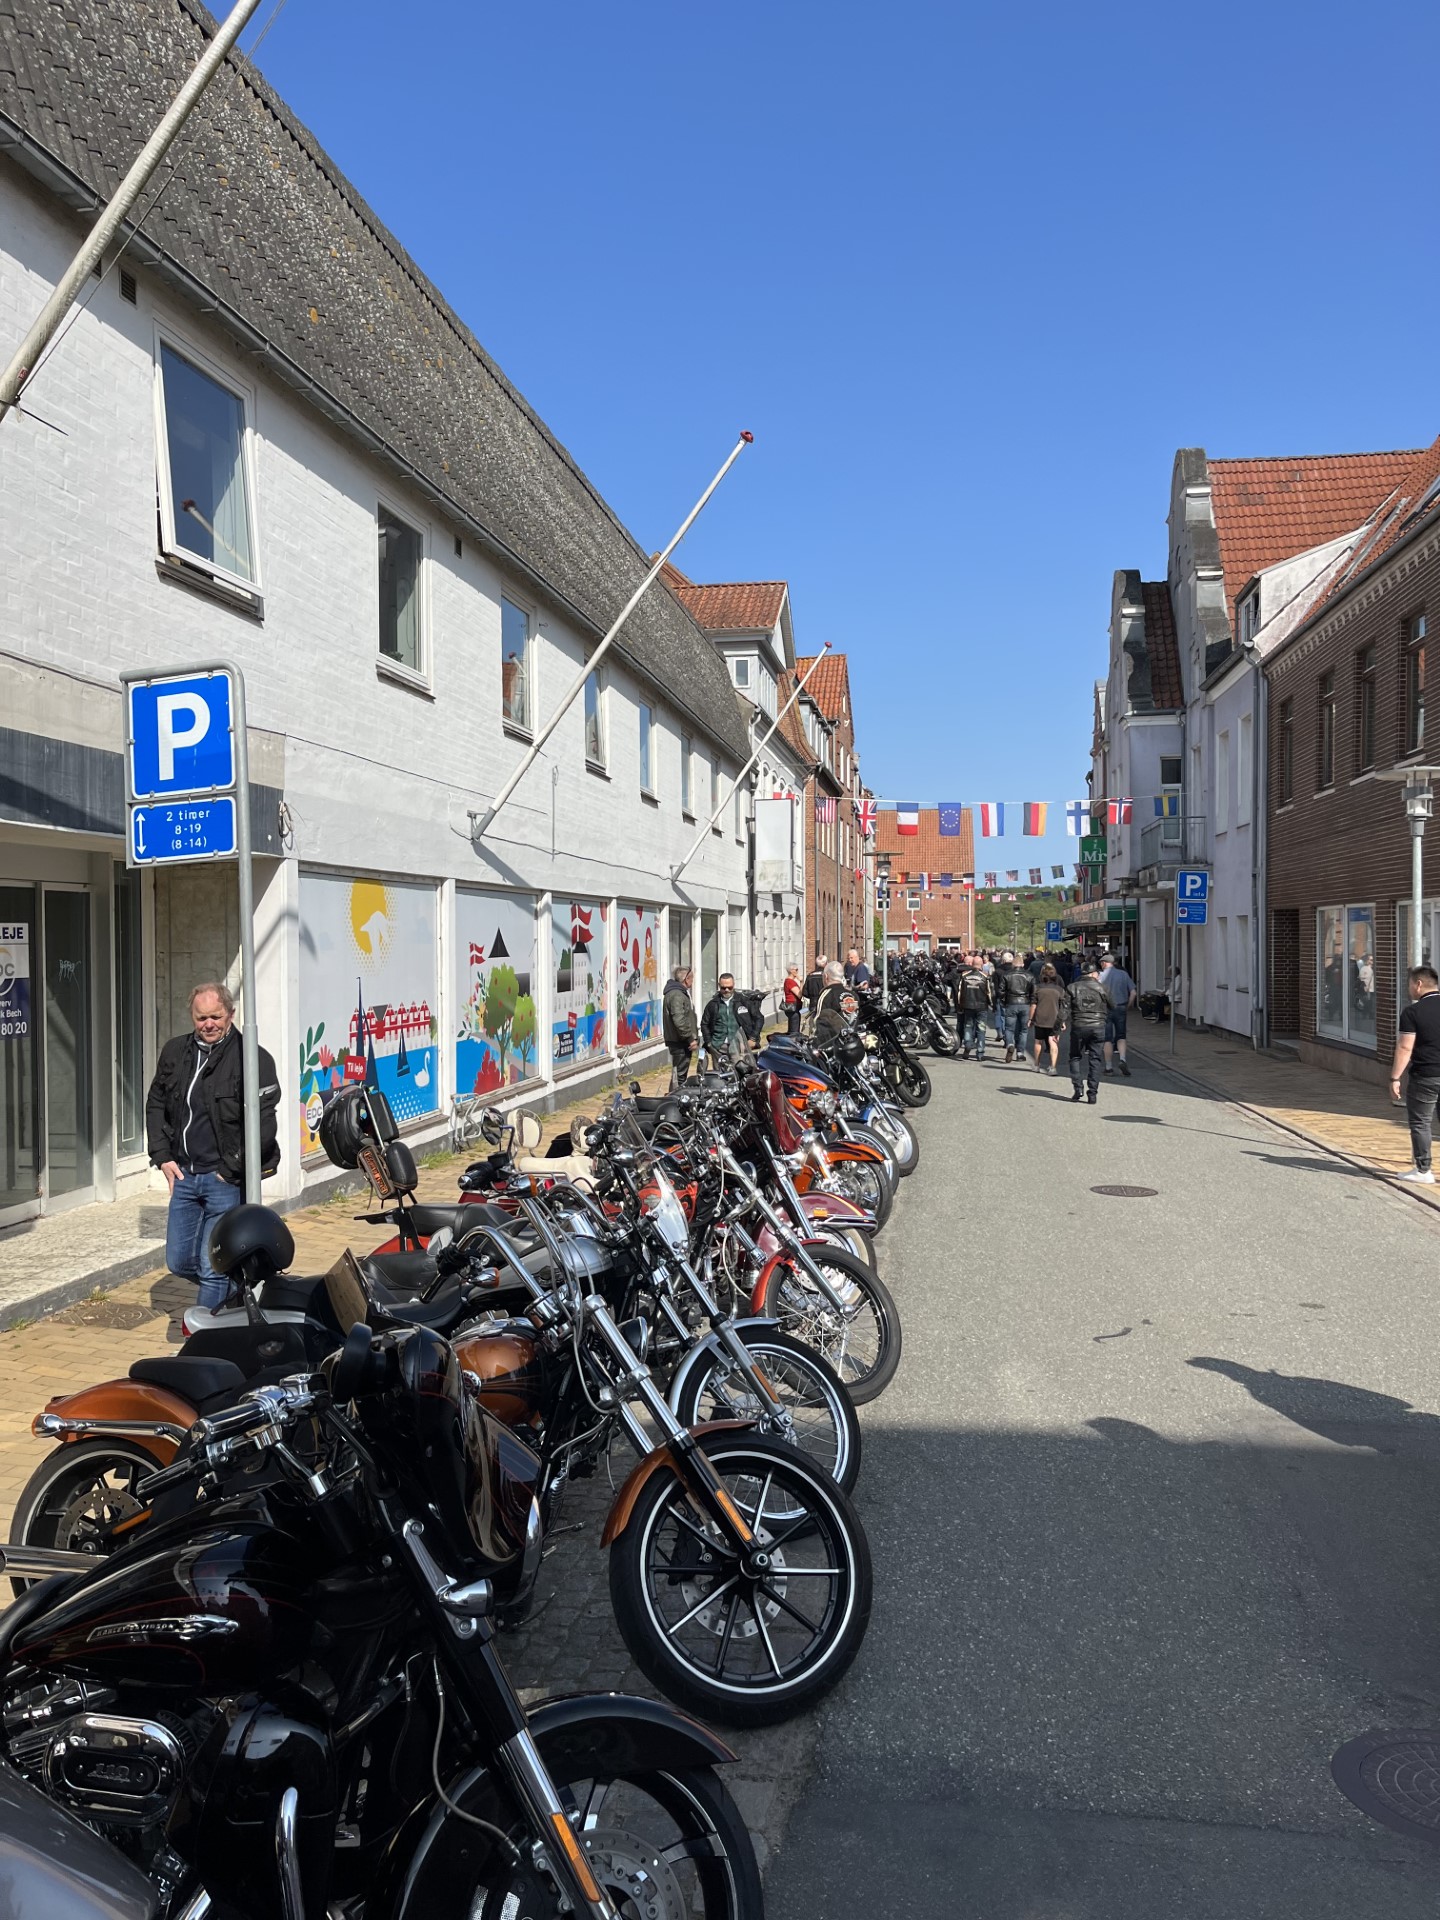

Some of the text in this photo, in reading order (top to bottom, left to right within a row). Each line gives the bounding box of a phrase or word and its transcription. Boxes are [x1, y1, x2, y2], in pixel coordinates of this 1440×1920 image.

[157, 692, 211, 781] P
[166, 808, 211, 822] 2 timer
[1185, 874, 1202, 897] P
[0, 927, 24, 939] EJE
[1049, 922, 1057, 931] P
[1, 1021, 27, 1035] 80 20
[306, 1105, 323, 1119] EDC
